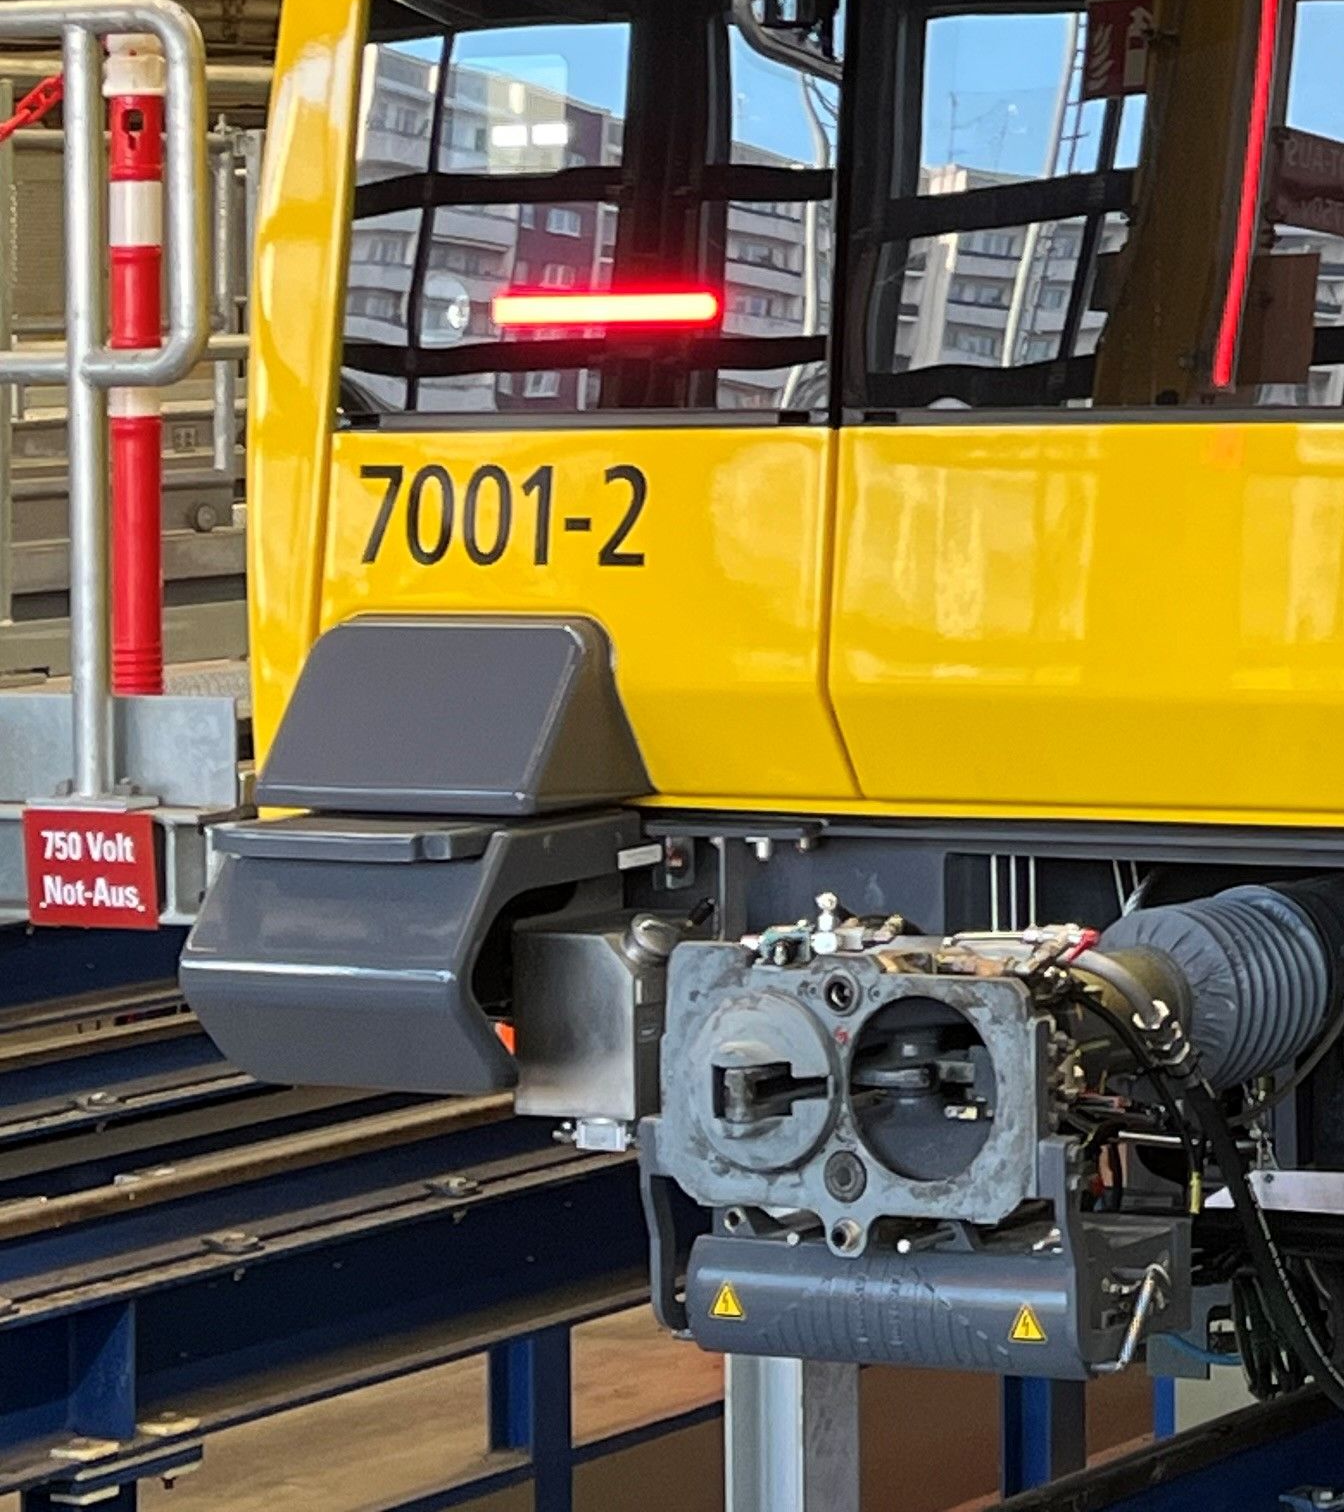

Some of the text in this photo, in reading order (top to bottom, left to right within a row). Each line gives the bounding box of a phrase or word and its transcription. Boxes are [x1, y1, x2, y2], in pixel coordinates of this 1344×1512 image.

[360, 464, 648, 567] 7001-2
[40, 830, 136, 863] 750 Volt
[42, 875, 140, 909] Not-Aus
